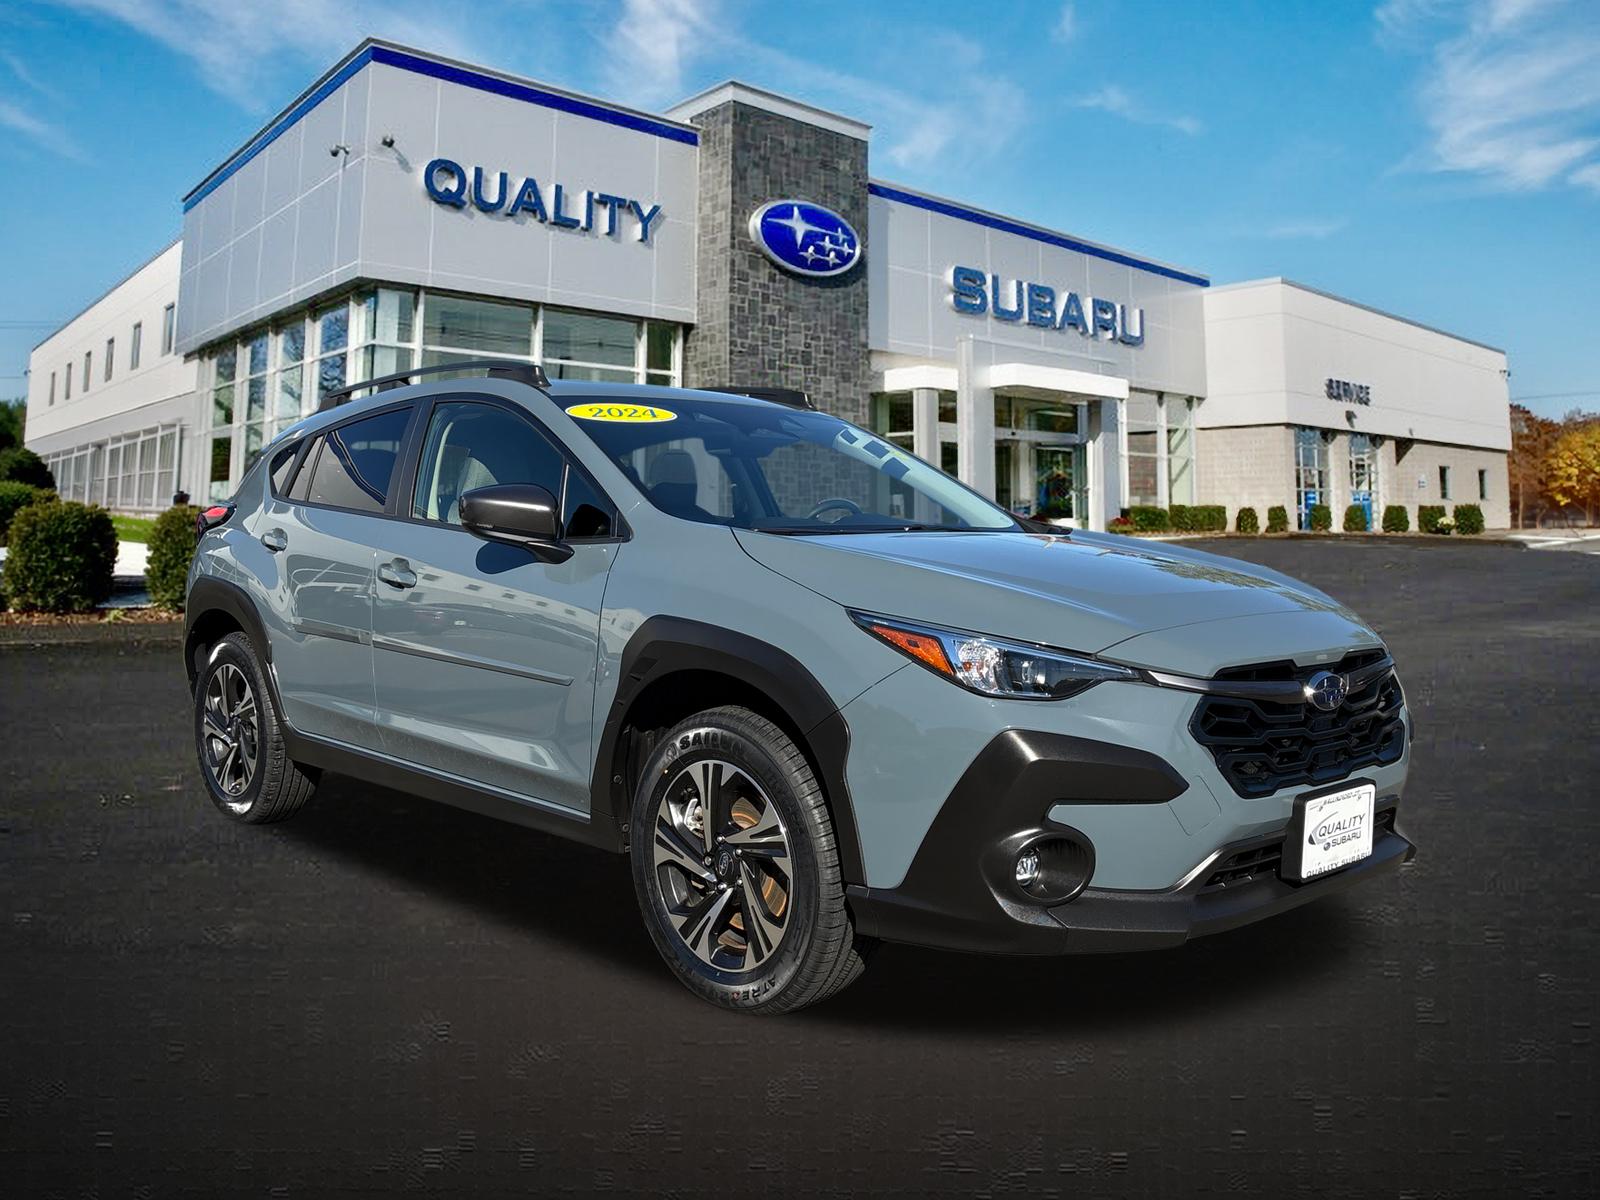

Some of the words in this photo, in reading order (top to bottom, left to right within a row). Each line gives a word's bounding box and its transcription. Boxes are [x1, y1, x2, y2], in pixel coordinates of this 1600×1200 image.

[424, 158, 661, 242] QUALITY
[951, 265, 1145, 346] SUBARU
[1325, 378, 1371, 406] SERVICE
[588, 406, 659, 419] 2024
[1318, 813, 1366, 838] QUALITY
[1331, 831, 1362, 847] SUBARU
[1306, 861, 1340, 877] QUALITY
